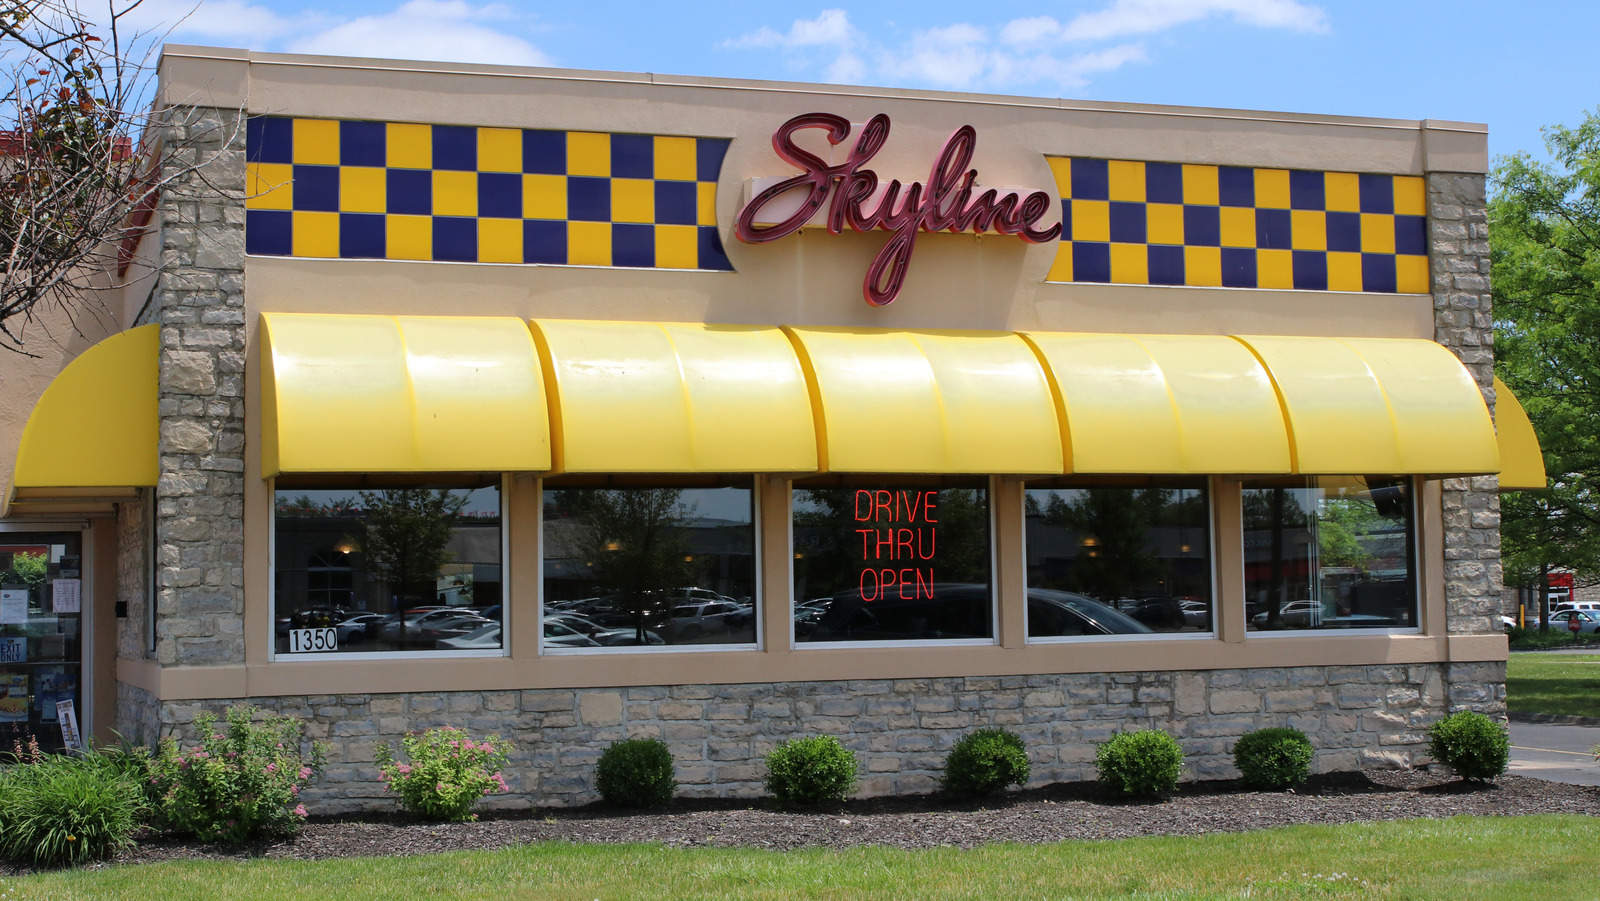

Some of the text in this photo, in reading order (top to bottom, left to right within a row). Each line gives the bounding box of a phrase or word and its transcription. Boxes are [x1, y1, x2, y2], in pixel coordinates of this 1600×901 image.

[735, 112, 1062, 307] Skyline
[855, 489, 938, 523] DRIVE
[855, 527, 936, 560] THRU
[860, 567, 934, 602] OPEN
[1, 643, 21, 653] EXIT
[293, 628, 337, 651] 1350
[1, 653, 21, 662] ONLY
